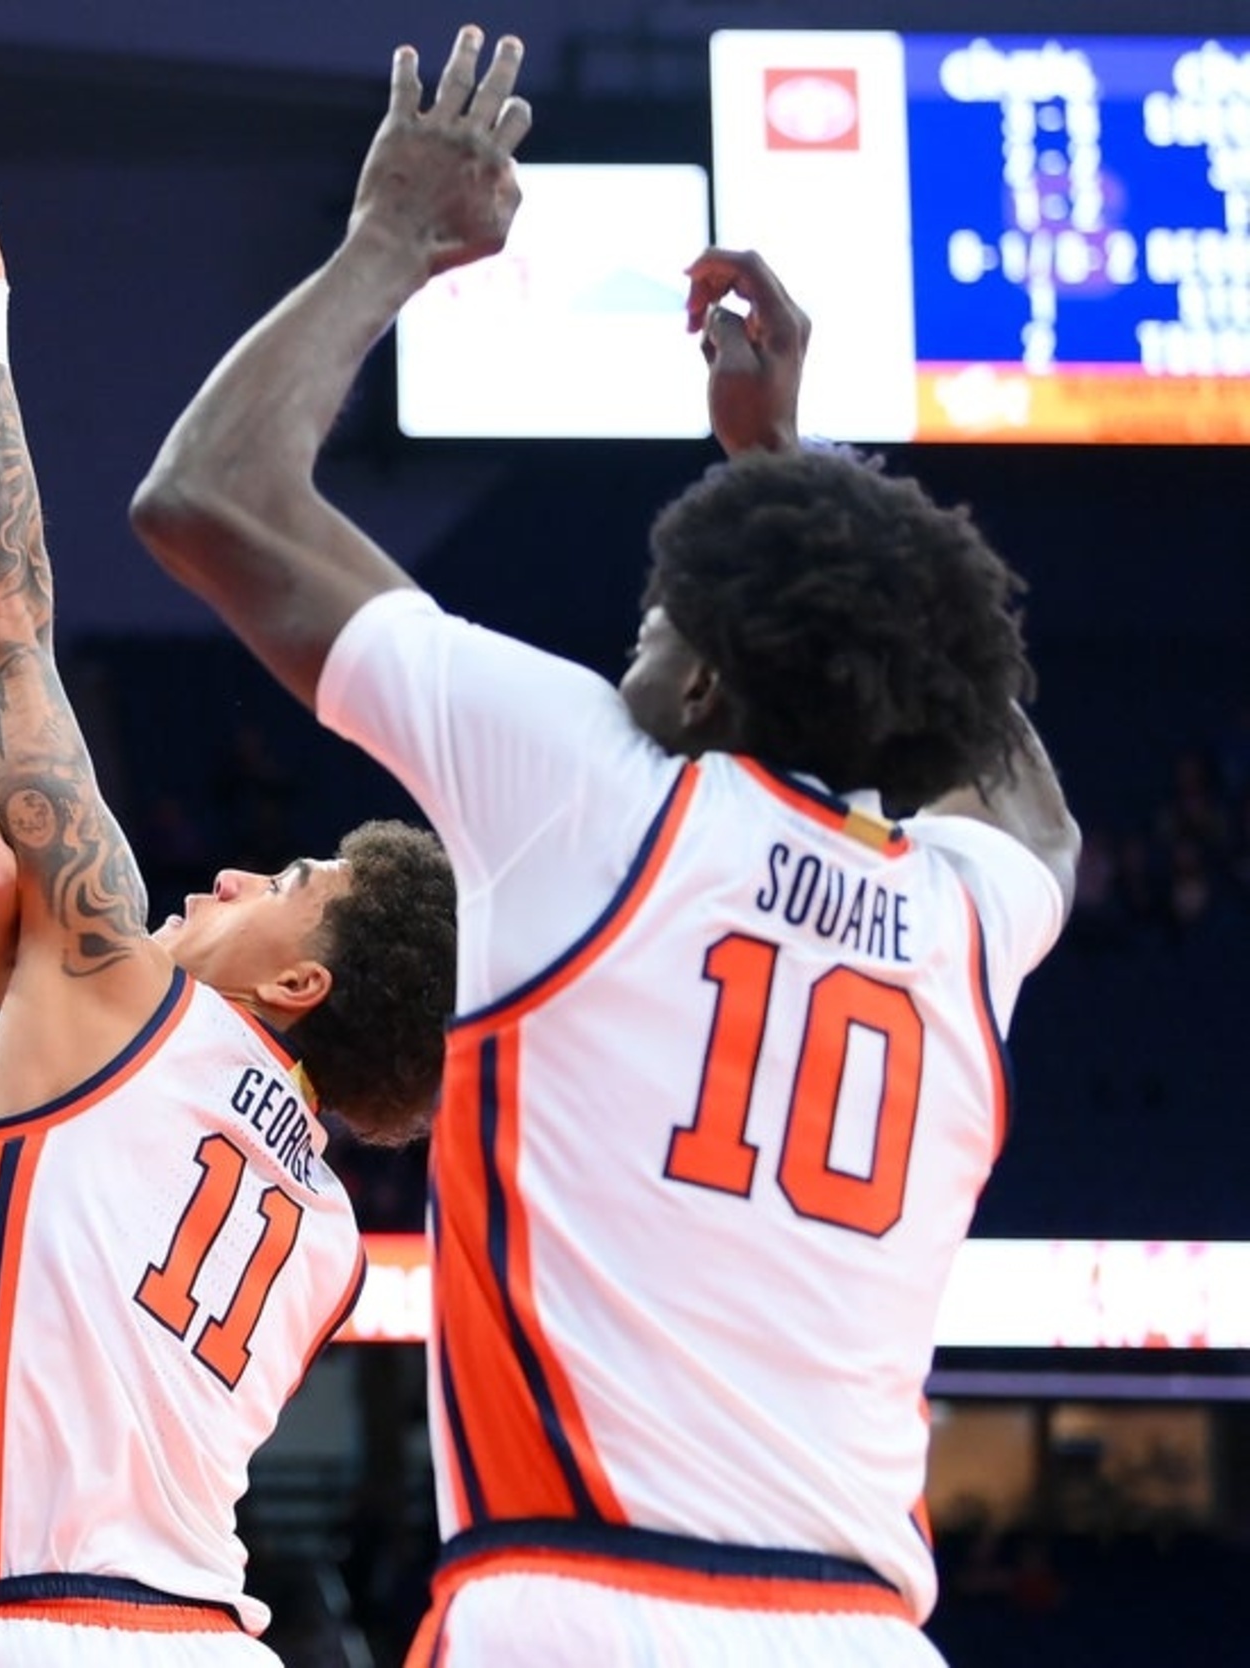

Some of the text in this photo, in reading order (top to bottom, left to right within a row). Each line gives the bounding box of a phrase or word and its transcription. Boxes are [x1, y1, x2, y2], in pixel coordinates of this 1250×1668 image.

[756, 842, 912, 963] SOUARE
[230, 1067, 319, 1195] GEORGE
[663, 931, 925, 1239] 10
[133, 1132, 305, 1393] 11
